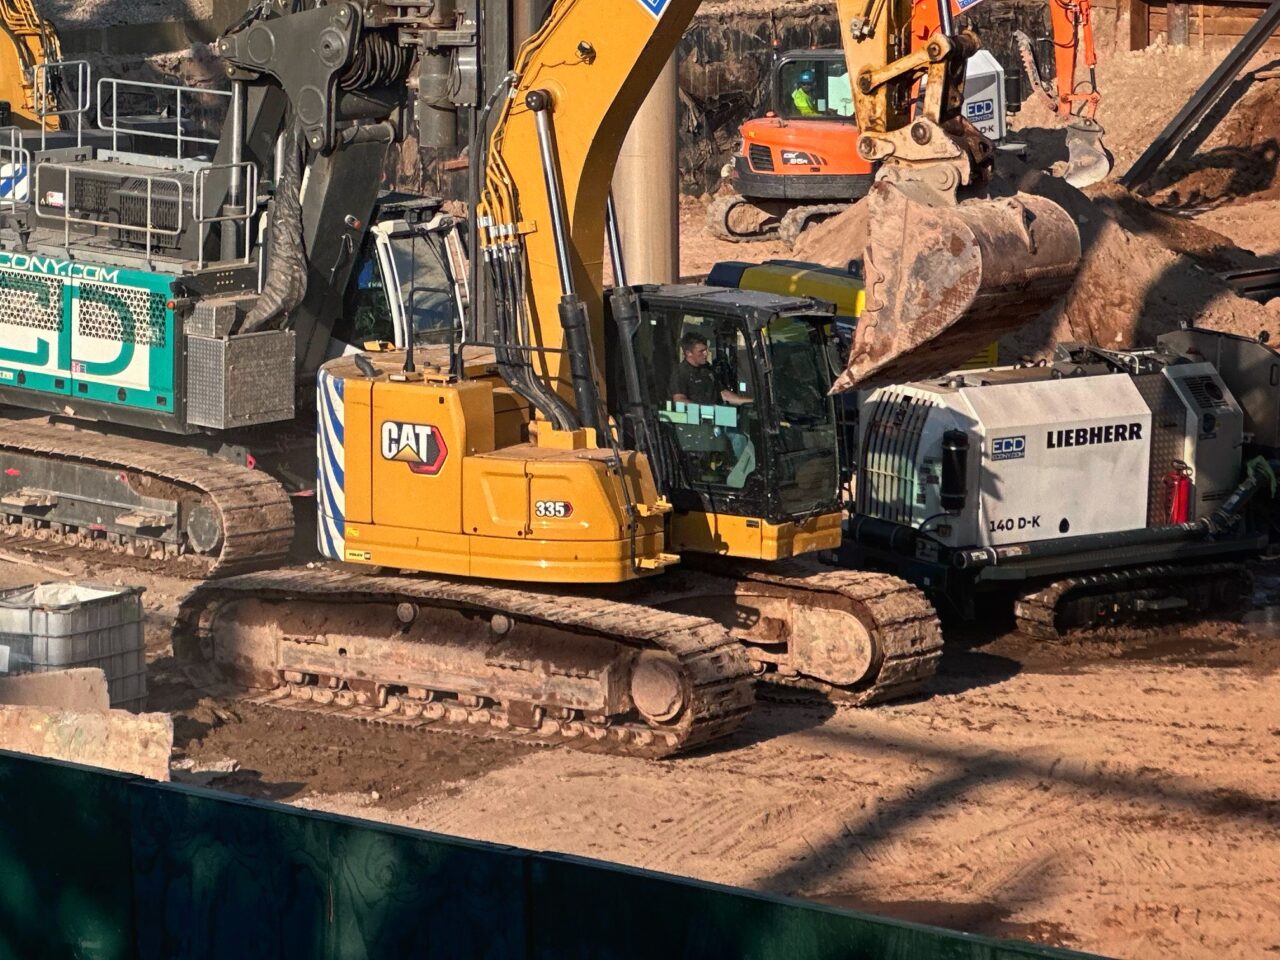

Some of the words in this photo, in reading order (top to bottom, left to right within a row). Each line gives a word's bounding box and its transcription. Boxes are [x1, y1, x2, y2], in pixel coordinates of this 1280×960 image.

[967, 100, 993, 116] ECD
[381, 421, 432, 463] CAT
[1046, 422, 1143, 449] LIEBHERR
[992, 437, 1025, 454] ECD
[535, 500, 565, 517] 335
[989, 518, 1014, 532] 140
[1017, 515, 1041, 529] D-K
